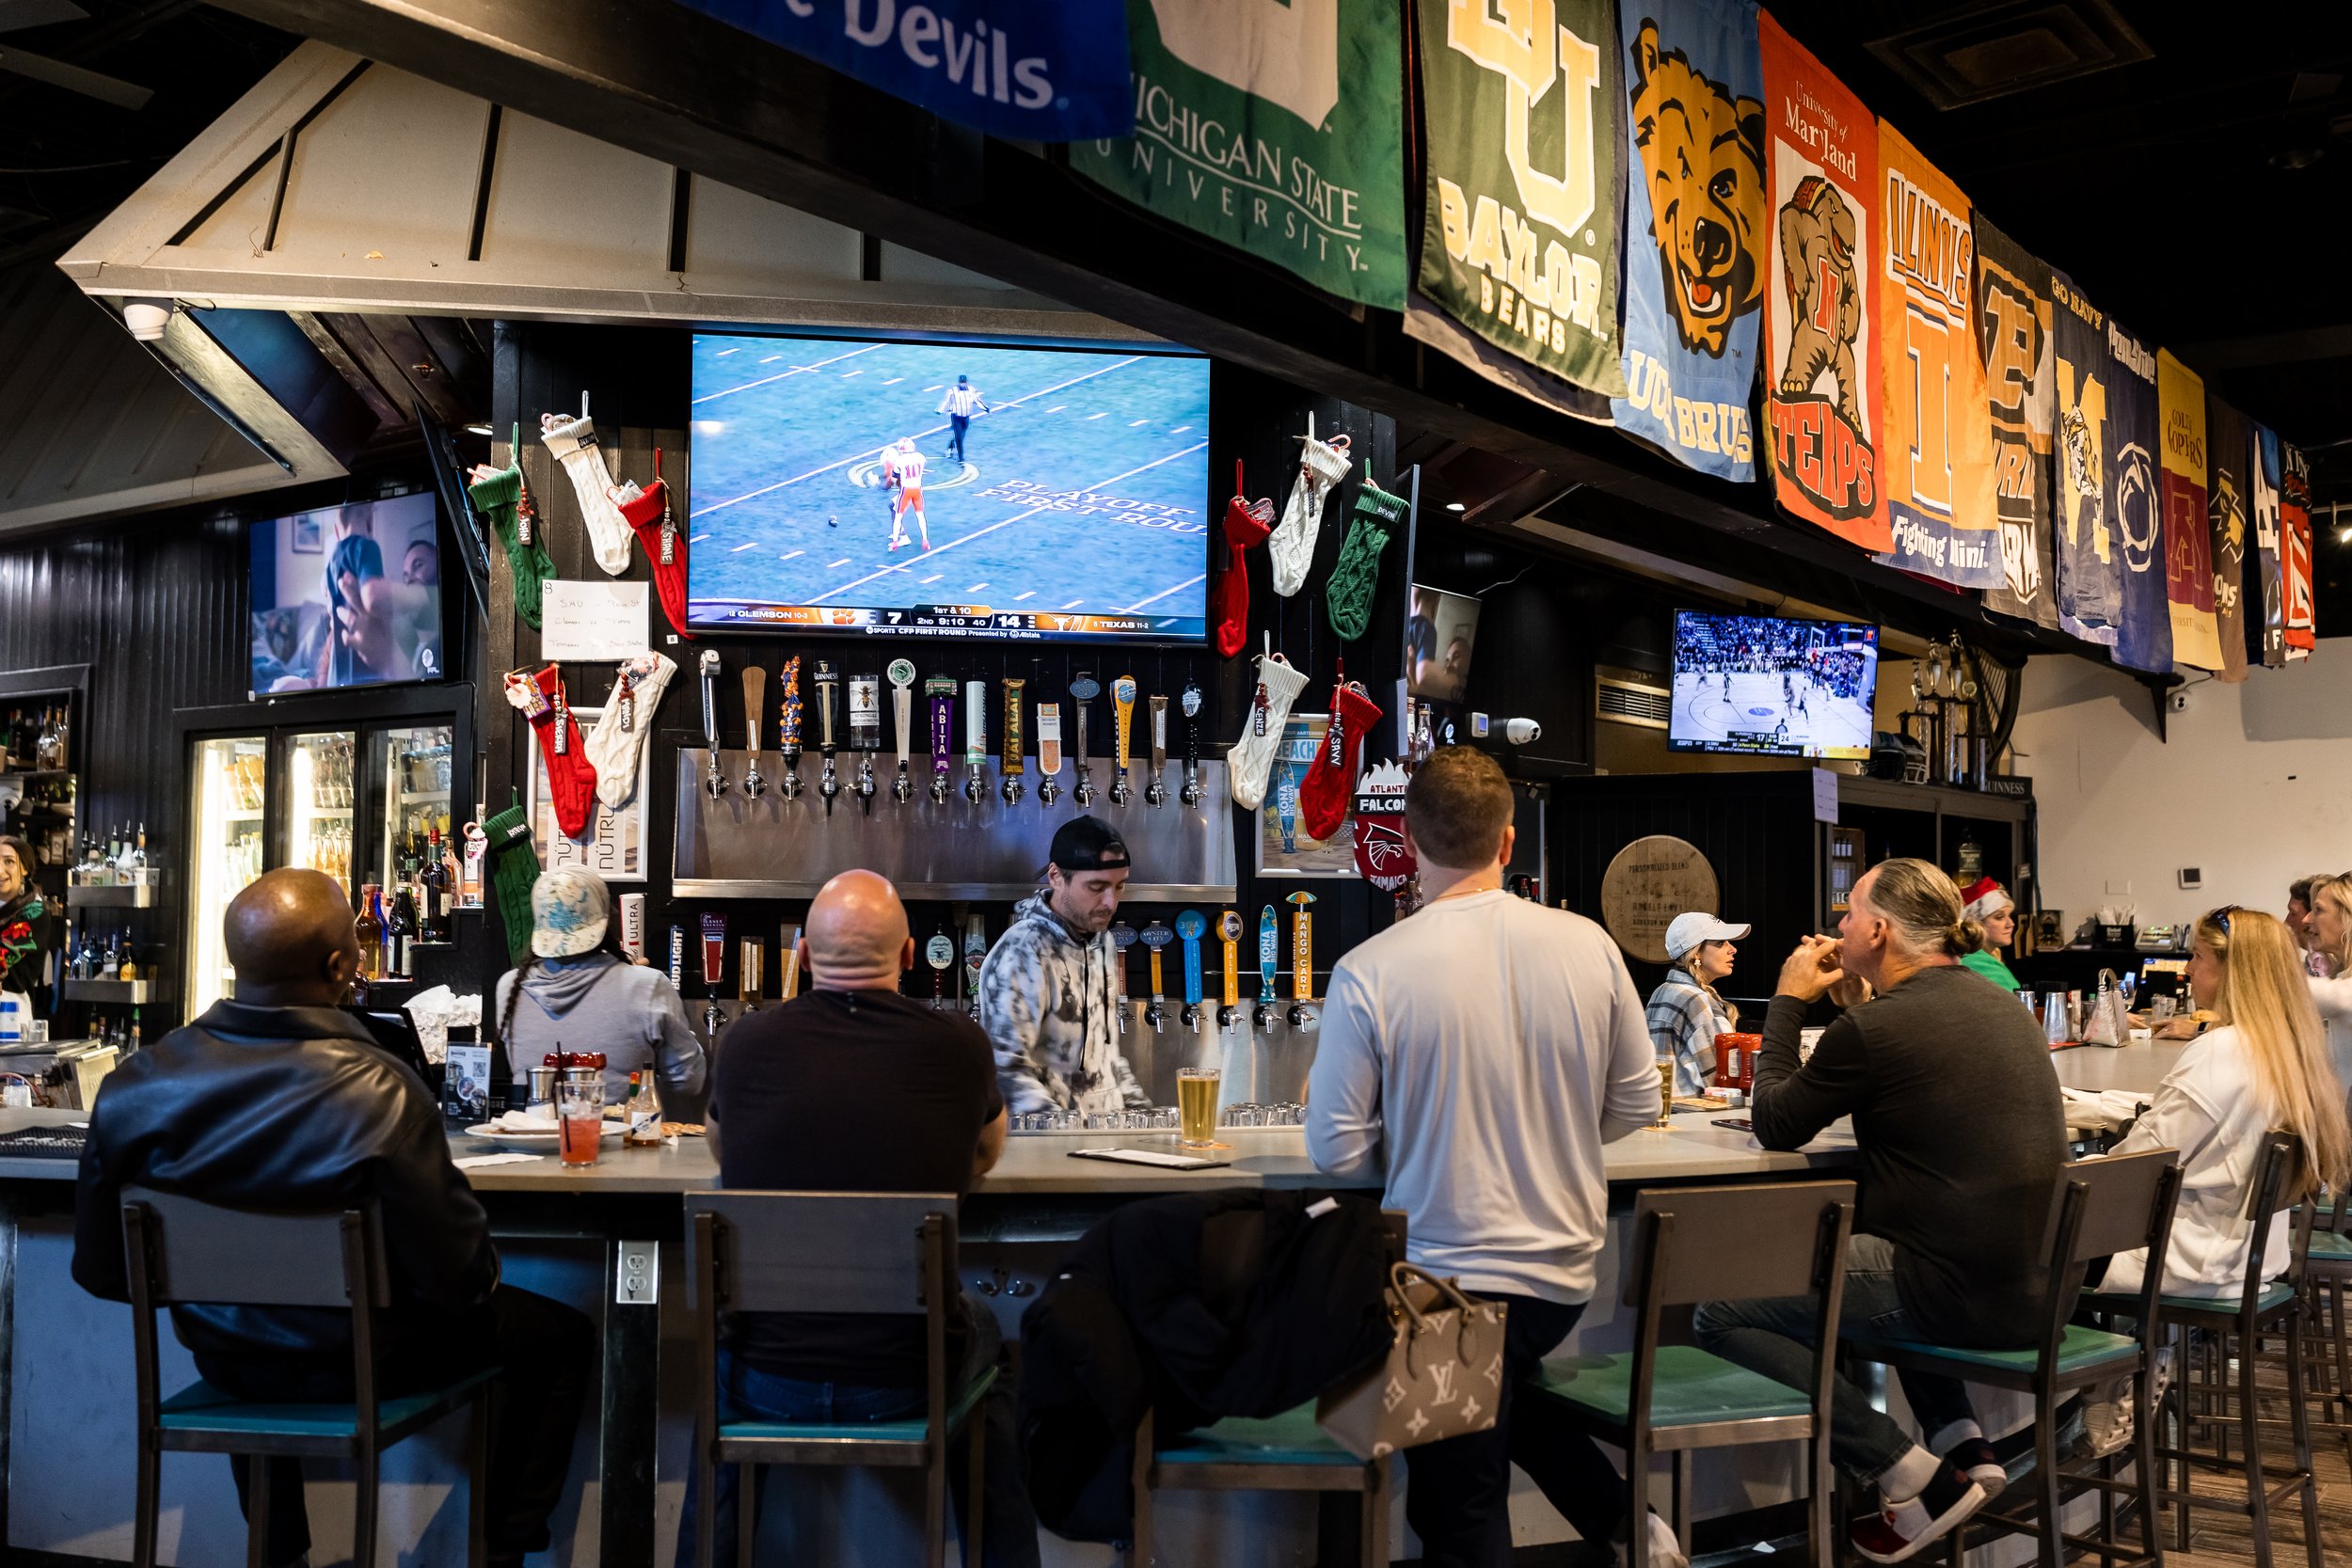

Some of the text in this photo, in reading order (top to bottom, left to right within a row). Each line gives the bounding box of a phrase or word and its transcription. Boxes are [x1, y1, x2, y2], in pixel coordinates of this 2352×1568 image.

[1131, 72, 1362, 230] ICHIGAN STATE
[1785, 95, 1857, 182] Maryland
[1438, 176, 1602, 338] BAYLOR
[1890, 176, 1973, 306] ILINOIS
[1480, 273, 1565, 355] BEARS
[2052, 276, 2103, 330] GO NAVY
[1772, 397, 1874, 509] TERPS
[972, 488, 1208, 537] FIRST ROU
[995, 478, 1199, 516] PLAYOFF
[1377, 506, 1397, 519] DEVIN
[518, 517, 531, 542] JOHN
[1890, 515, 1947, 568] Fighting
[661, 531, 673, 562] SHANE
[544, 581, 553, 594] 8
[560, 599, 584, 609] SMU
[737, 610, 793, 620] CLEMSON
[793, 611, 809, 620] 10-3
[887, 611, 902, 625] 7
[932, 606, 972, 615] 1ST & 10
[916, 617, 986, 627] 2ND 9:10 40
[939, 628, 967, 637] ROUND
[968, 629, 999, 638] Presented
[997, 615, 1021, 628] 14
[1099, 621, 1136, 629] TEXAS
[813, 672, 838, 681] GUINNESS
[621, 697, 632, 729] MANDI
[938, 704, 946, 754] ABITA
[1009, 697, 1019, 761] JAI ALAI
[1254, 706, 1265, 736] KENZIE
[1756, 734, 1766, 742] 17
[1279, 784, 1289, 816] KONA
[1359, 799, 1406, 811] FALCO
[1370, 874, 1407, 892] JAMAICA
[629, 902, 639, 939] ULTRA
[671, 930, 683, 991] BUD LIGHT
[1262, 930, 1271, 963] KONA
[1299, 913, 1308, 992] MANGO CART
